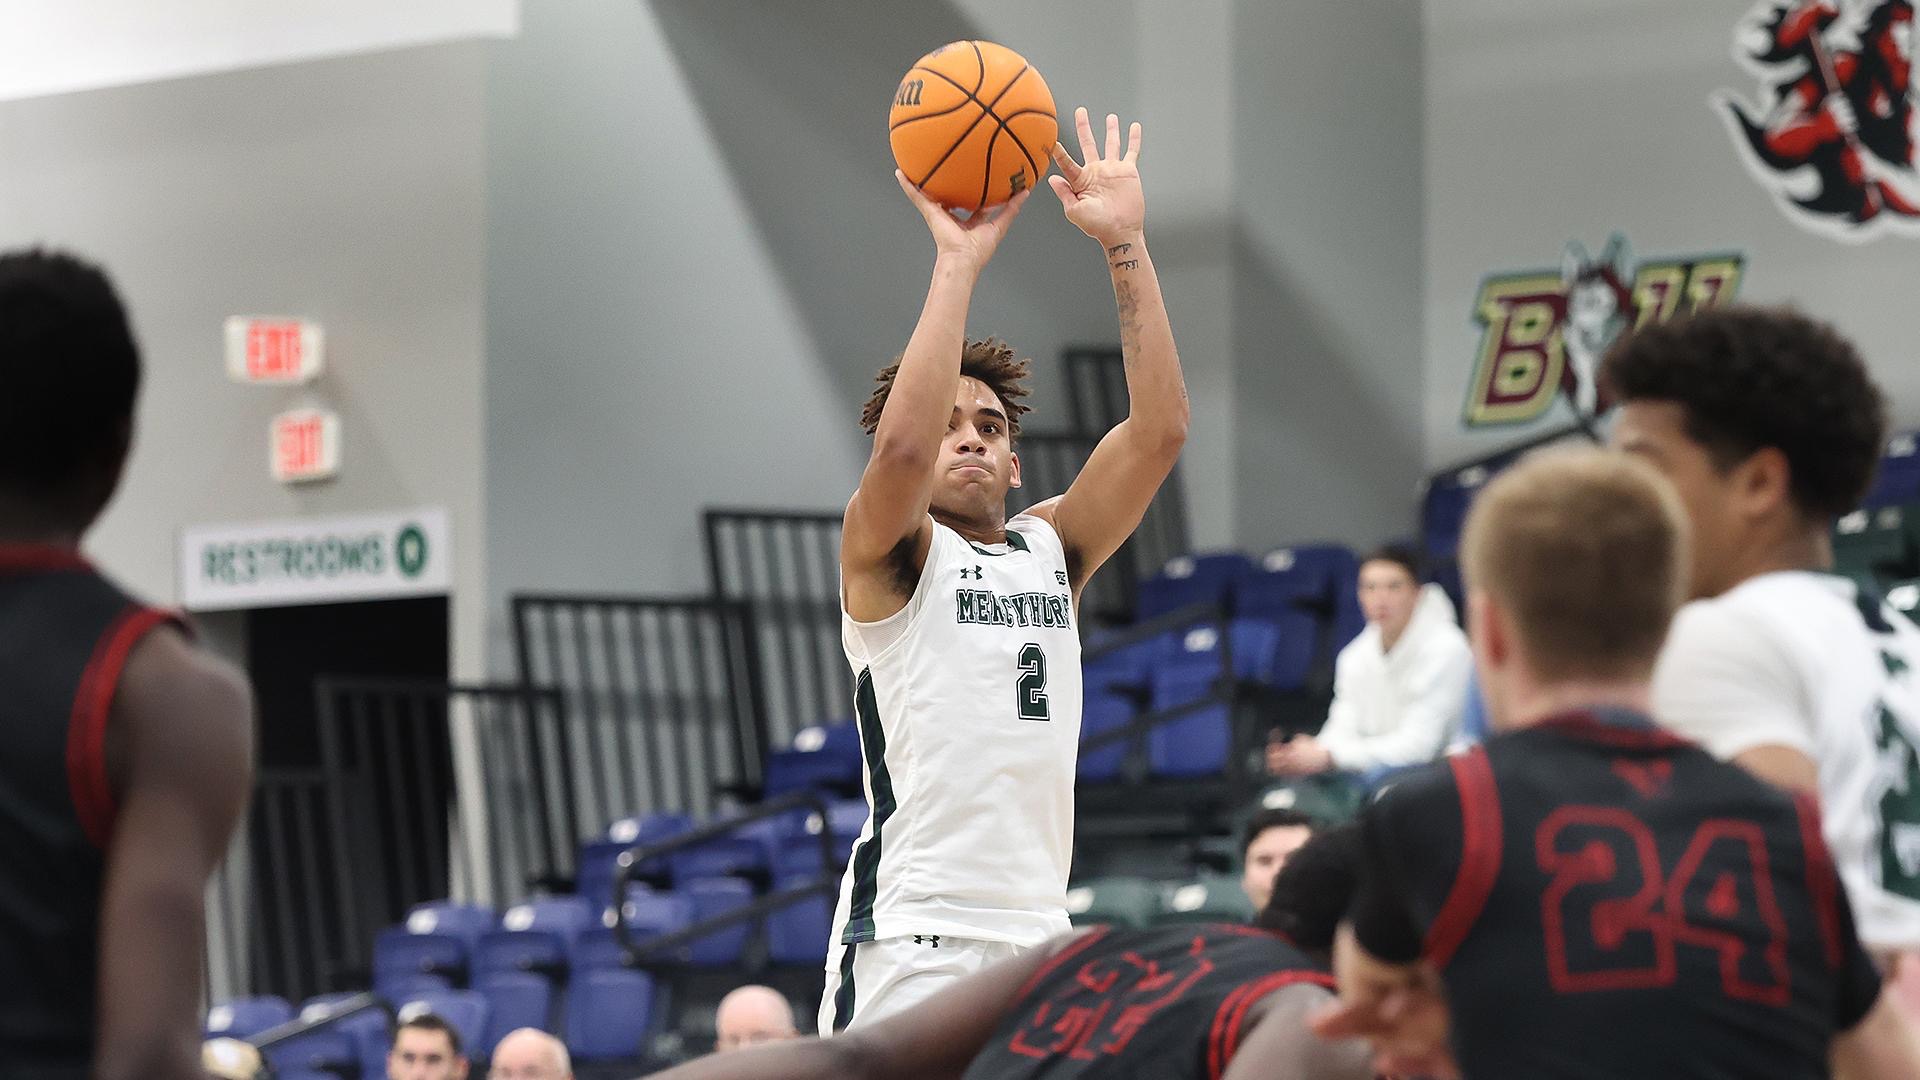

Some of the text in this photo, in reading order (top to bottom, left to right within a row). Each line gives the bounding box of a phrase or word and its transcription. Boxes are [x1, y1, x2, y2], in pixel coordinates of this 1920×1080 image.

[203, 535, 385, 583] RESTROOMS
[956, 589, 1071, 630] MERCYHUR
[1016, 643, 1050, 721] 2
[1535, 806, 1791, 1007] 24
